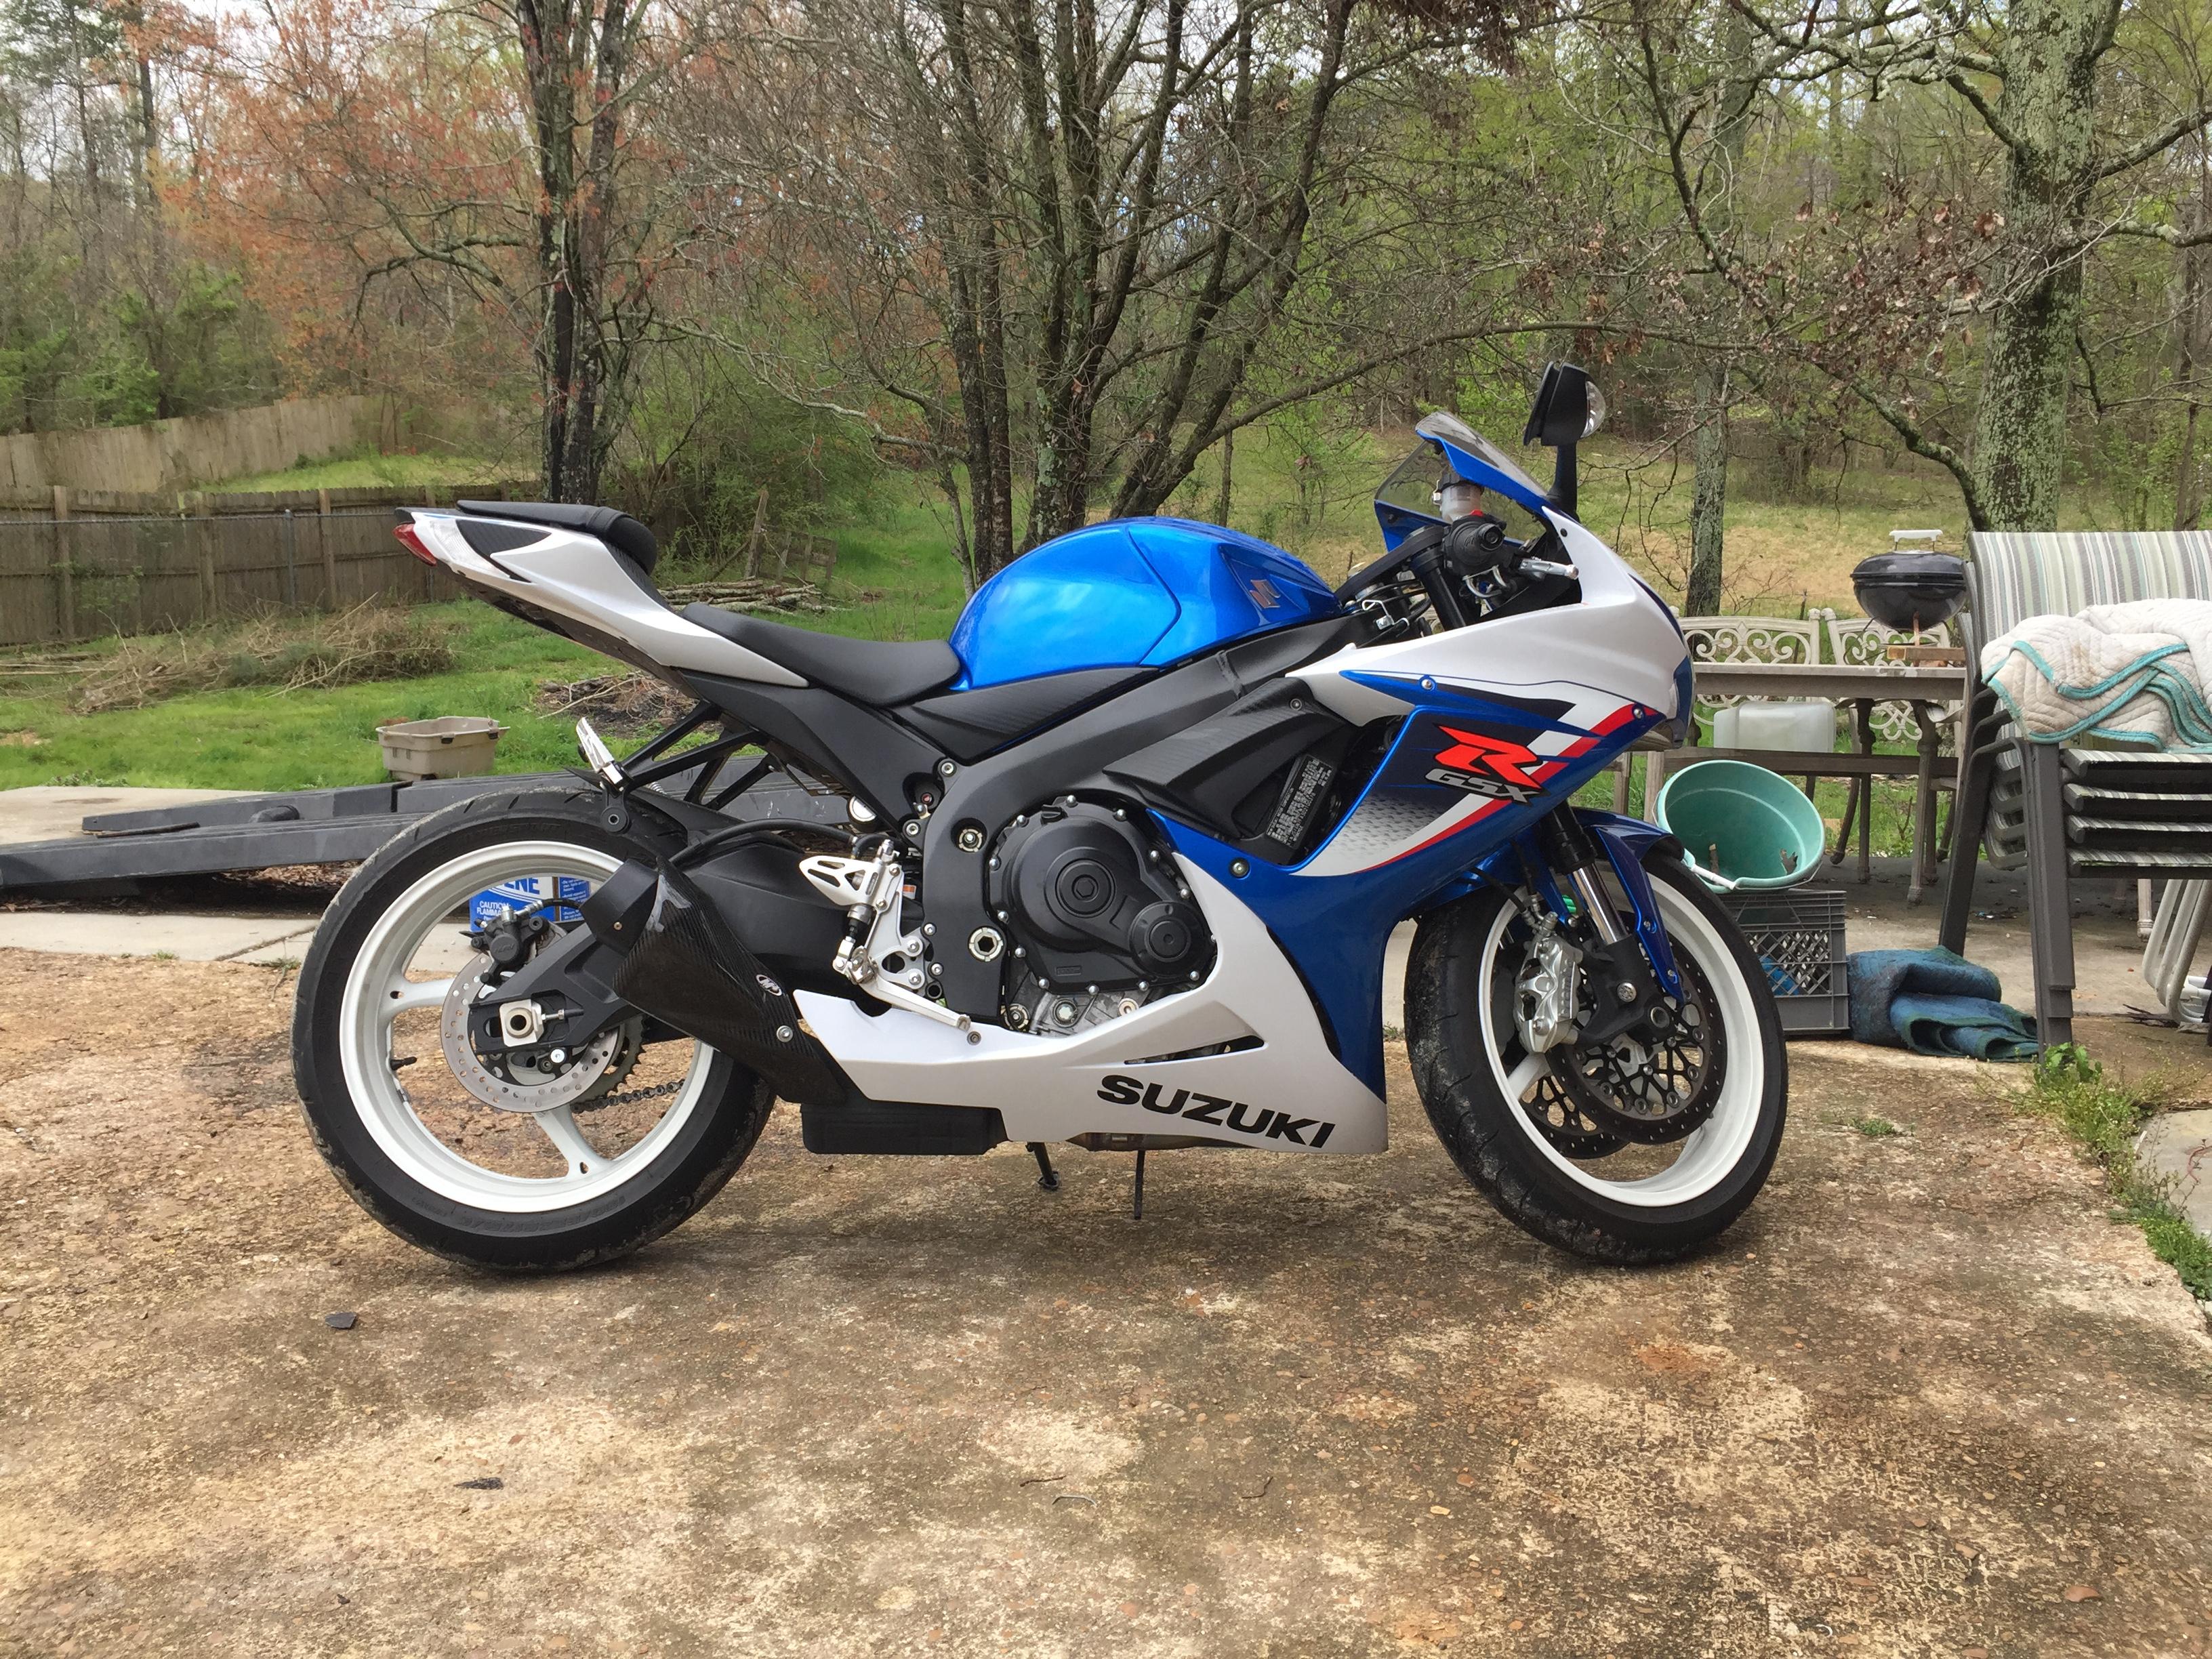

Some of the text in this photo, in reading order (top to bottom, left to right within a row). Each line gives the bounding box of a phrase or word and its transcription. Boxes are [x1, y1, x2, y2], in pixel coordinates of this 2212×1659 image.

[1426, 769, 1540, 802] GSX
[1436, 726, 1542, 789] R
[1097, 1074, 1336, 1149] SUZUKI
